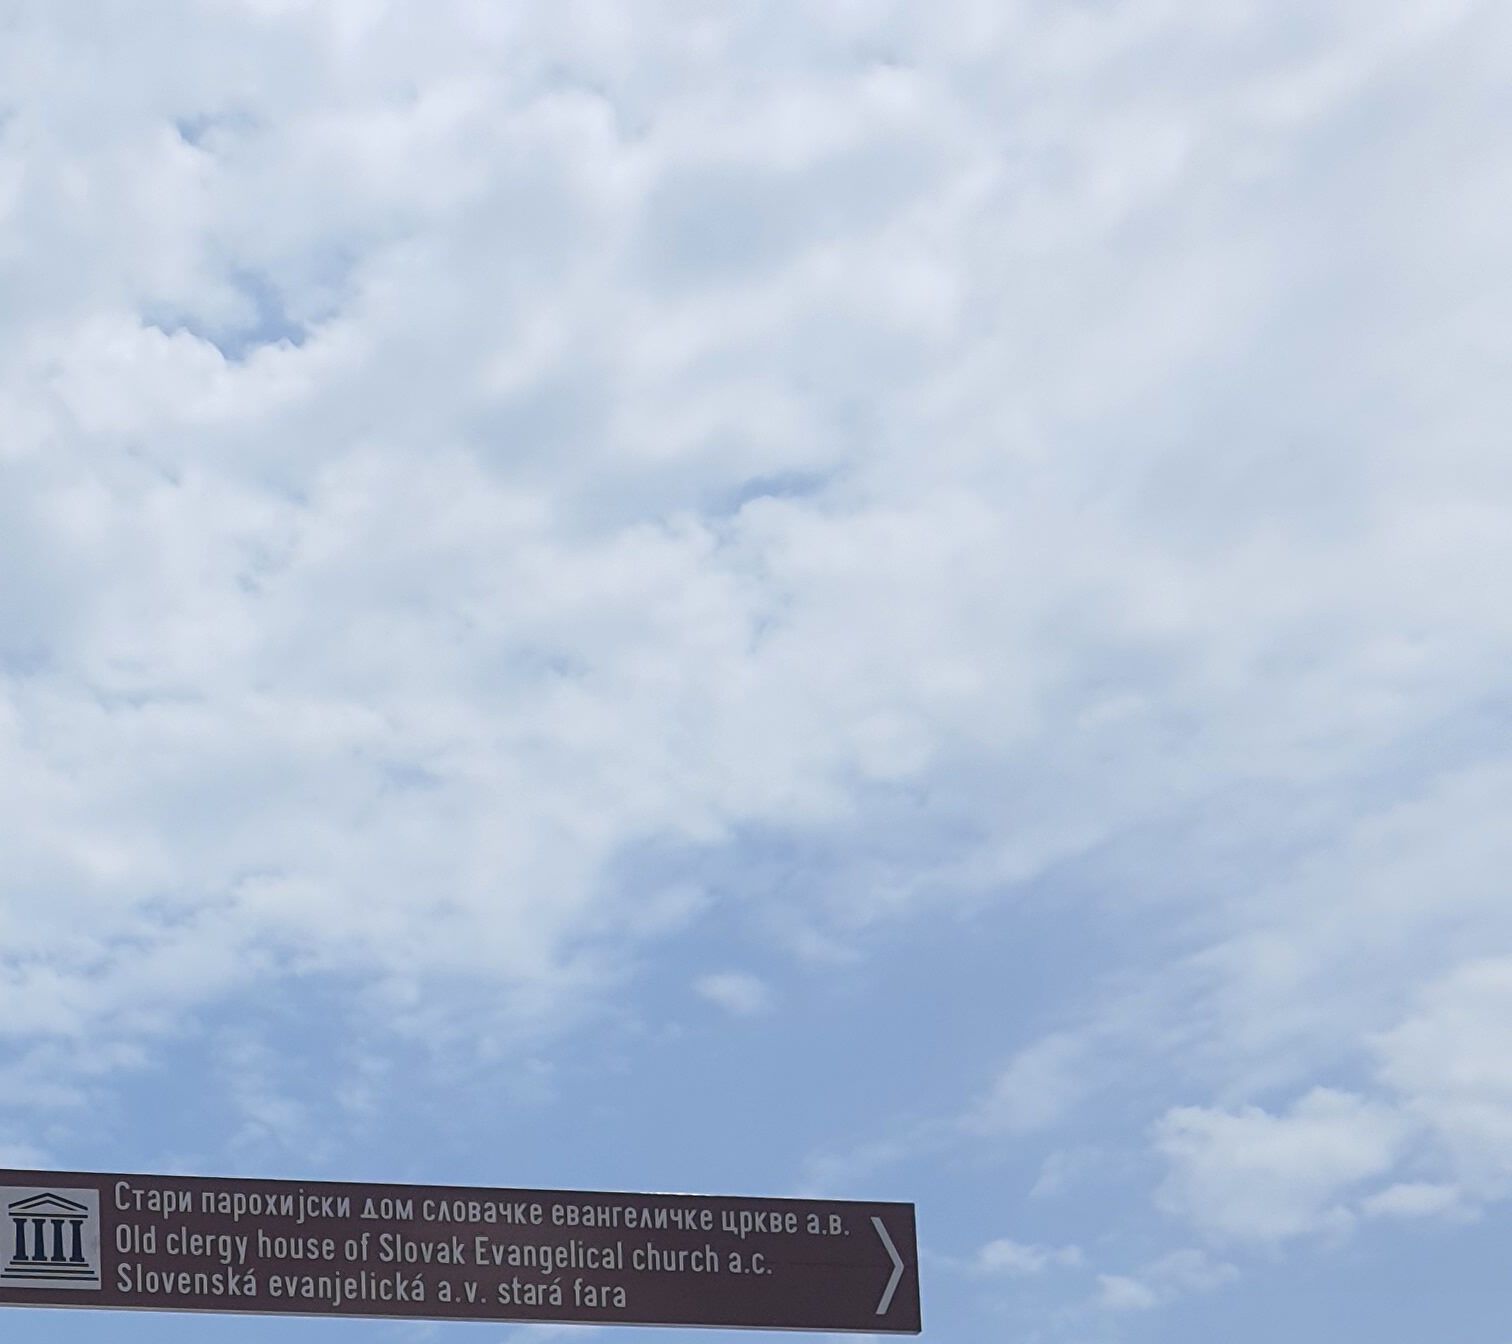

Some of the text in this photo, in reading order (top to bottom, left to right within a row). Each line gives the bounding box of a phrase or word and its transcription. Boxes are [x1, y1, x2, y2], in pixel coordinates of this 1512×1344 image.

[114, 1181, 850, 1239] Стари парохијски дом словачке евангеличке цркве а.в.
[115, 1224, 773, 1275] Old clergy house of Slovak Evangelical church a.c.
[116, 1262, 627, 1308] Slovenská evanjelická a.v. stará fara
